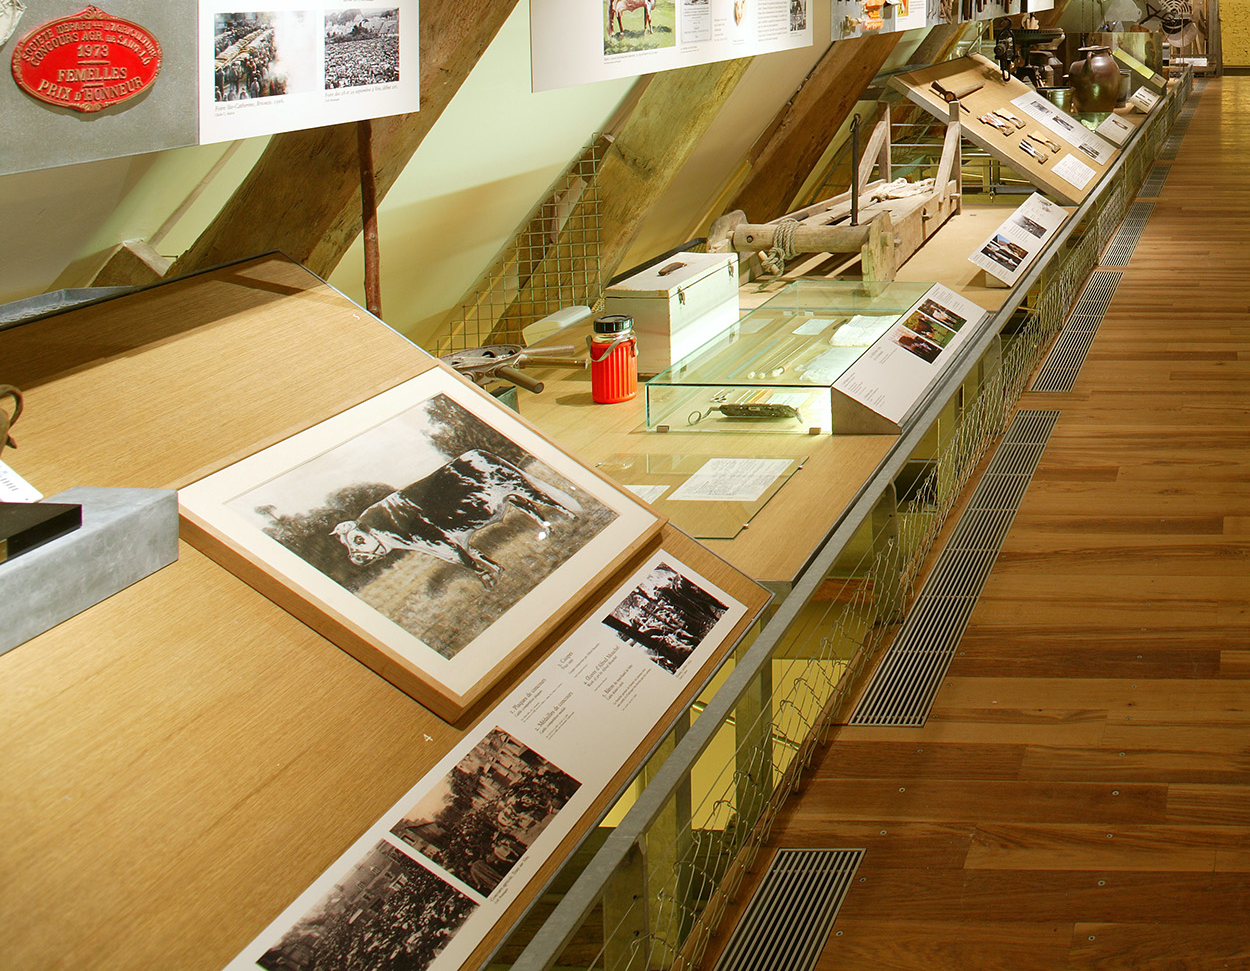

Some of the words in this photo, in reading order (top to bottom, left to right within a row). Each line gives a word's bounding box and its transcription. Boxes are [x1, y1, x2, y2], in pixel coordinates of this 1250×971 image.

[30, 32, 79, 67] CONCOURS
[77, 44, 109, 58] 1973
[57, 67, 128, 82] FEMELLES
[38, 79, 73, 101] PRIX
[74, 76, 143, 101] D'HONNEUR
[512, 696, 527, 710] Plaques
